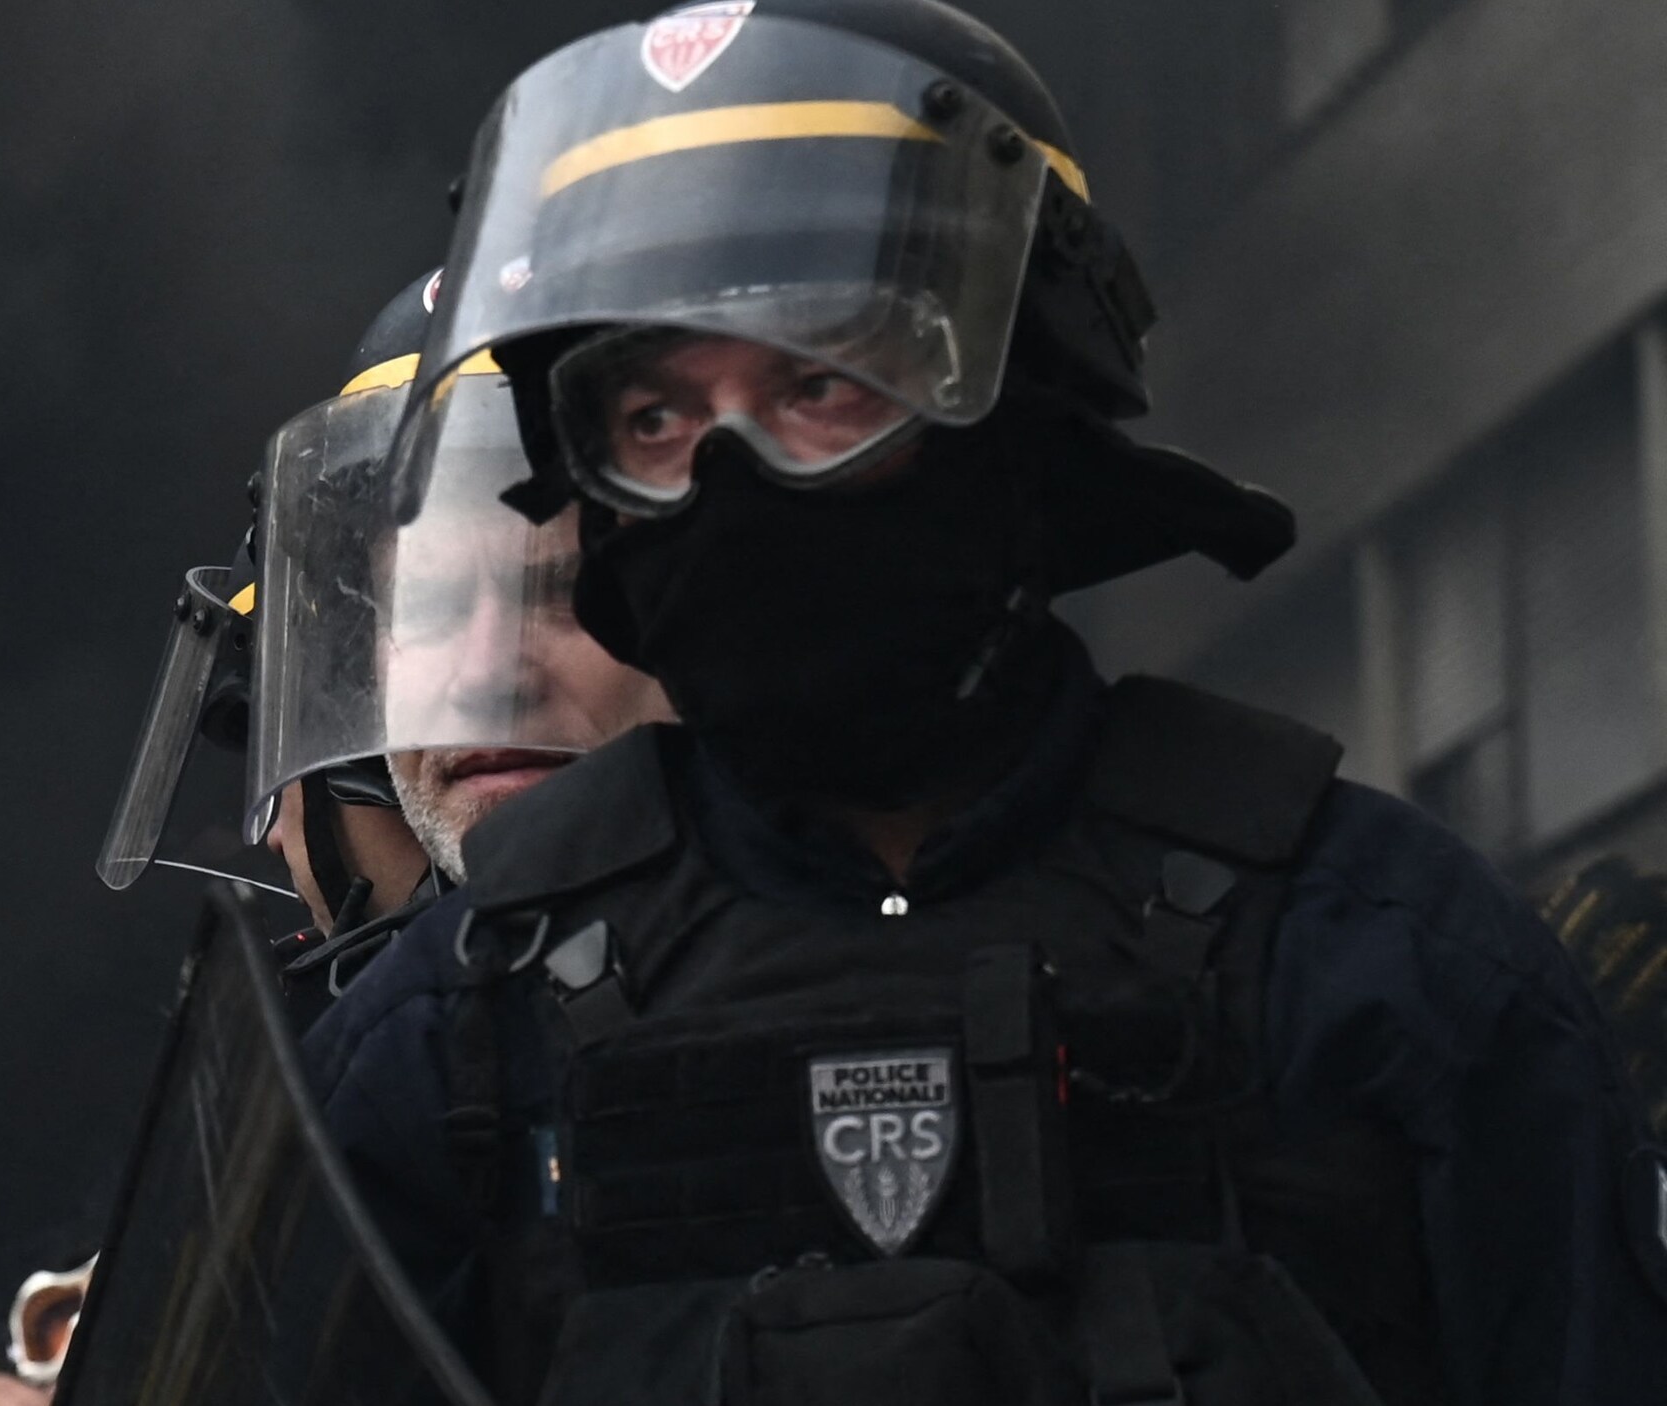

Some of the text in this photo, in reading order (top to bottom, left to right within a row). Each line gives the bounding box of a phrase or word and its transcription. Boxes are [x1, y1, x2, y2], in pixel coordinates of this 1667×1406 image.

[834, 1063, 929, 1087] POLICE
[818, 1083, 946, 1108] NATIONALE
[823, 1110, 943, 1164] CRS
